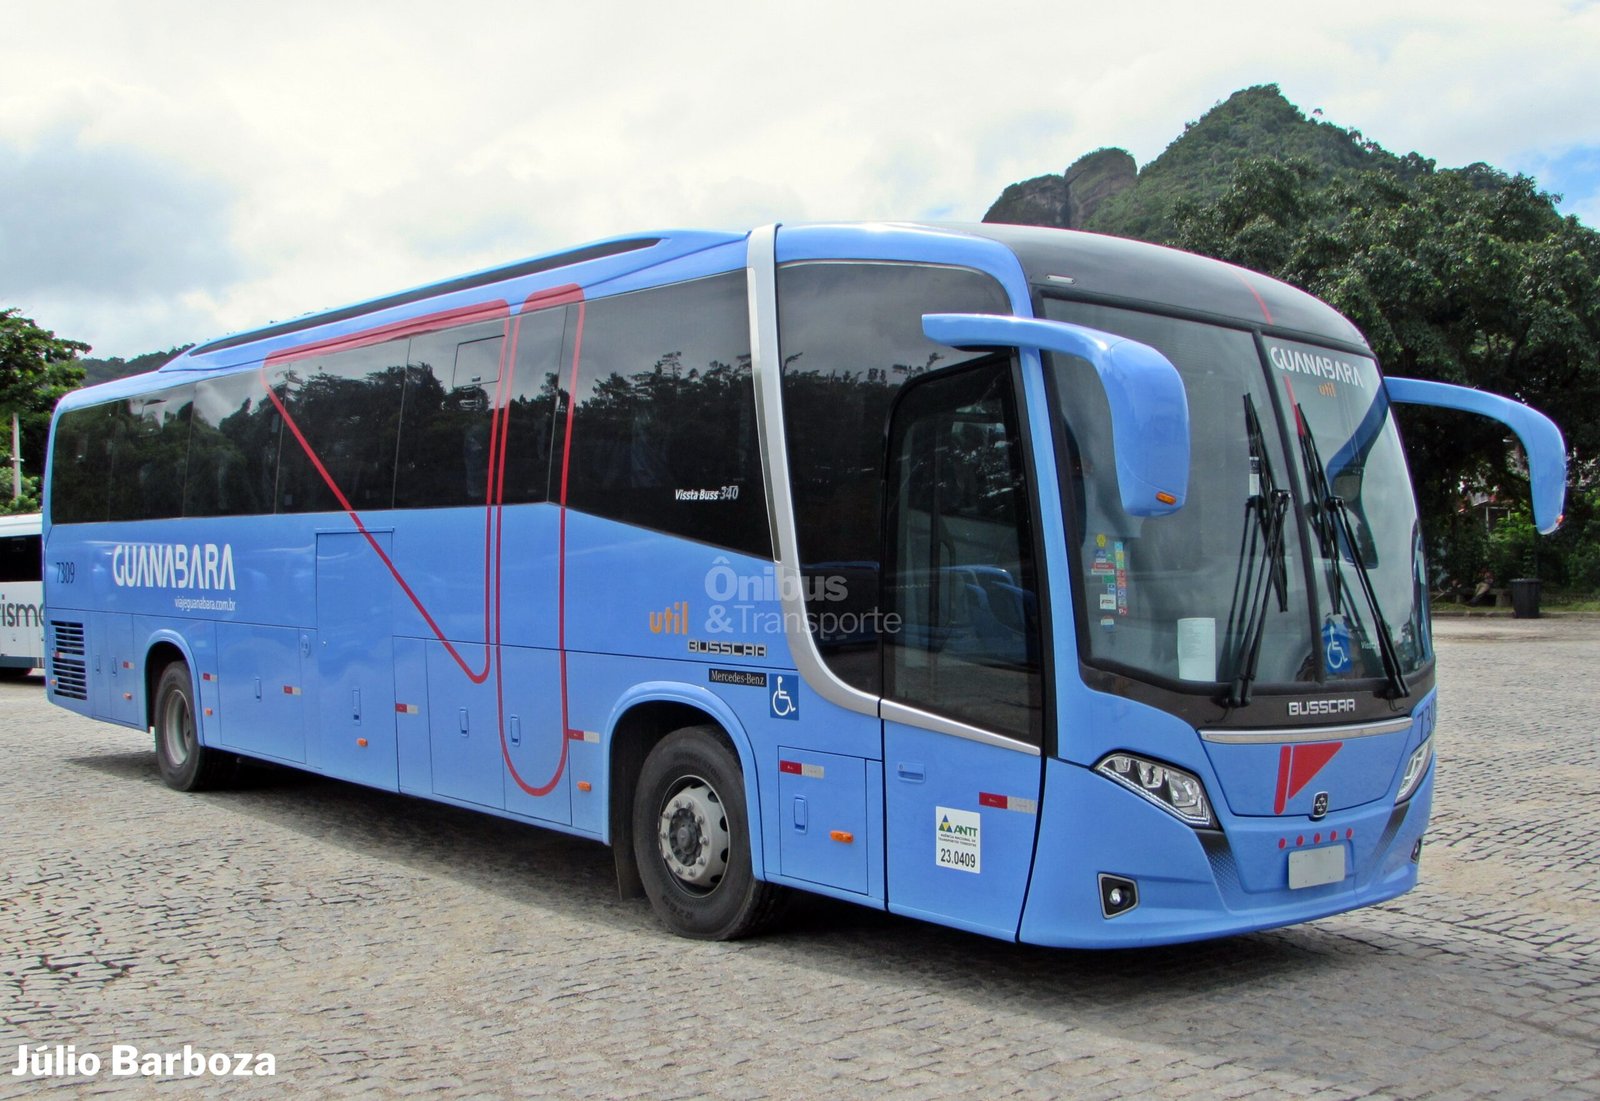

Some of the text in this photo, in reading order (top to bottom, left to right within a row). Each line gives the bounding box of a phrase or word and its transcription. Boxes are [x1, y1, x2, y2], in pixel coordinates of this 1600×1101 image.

[1270, 347, 1364, 388] GUANABARA
[675, 485, 739, 500] Vissta Buss 340
[56, 561, 76, 584] 7309
[112, 543, 236, 591] GUANABARA
[0, 594, 45, 627] ism
[649, 601, 689, 635] util
[687, 639, 767, 657] BUSSCAR
[710, 669, 766, 686] Mercedes-Benz
[1288, 699, 1356, 716] BUSSCAR
[953, 825, 978, 837] ANTT
[940, 848, 976, 868] 23.0409
